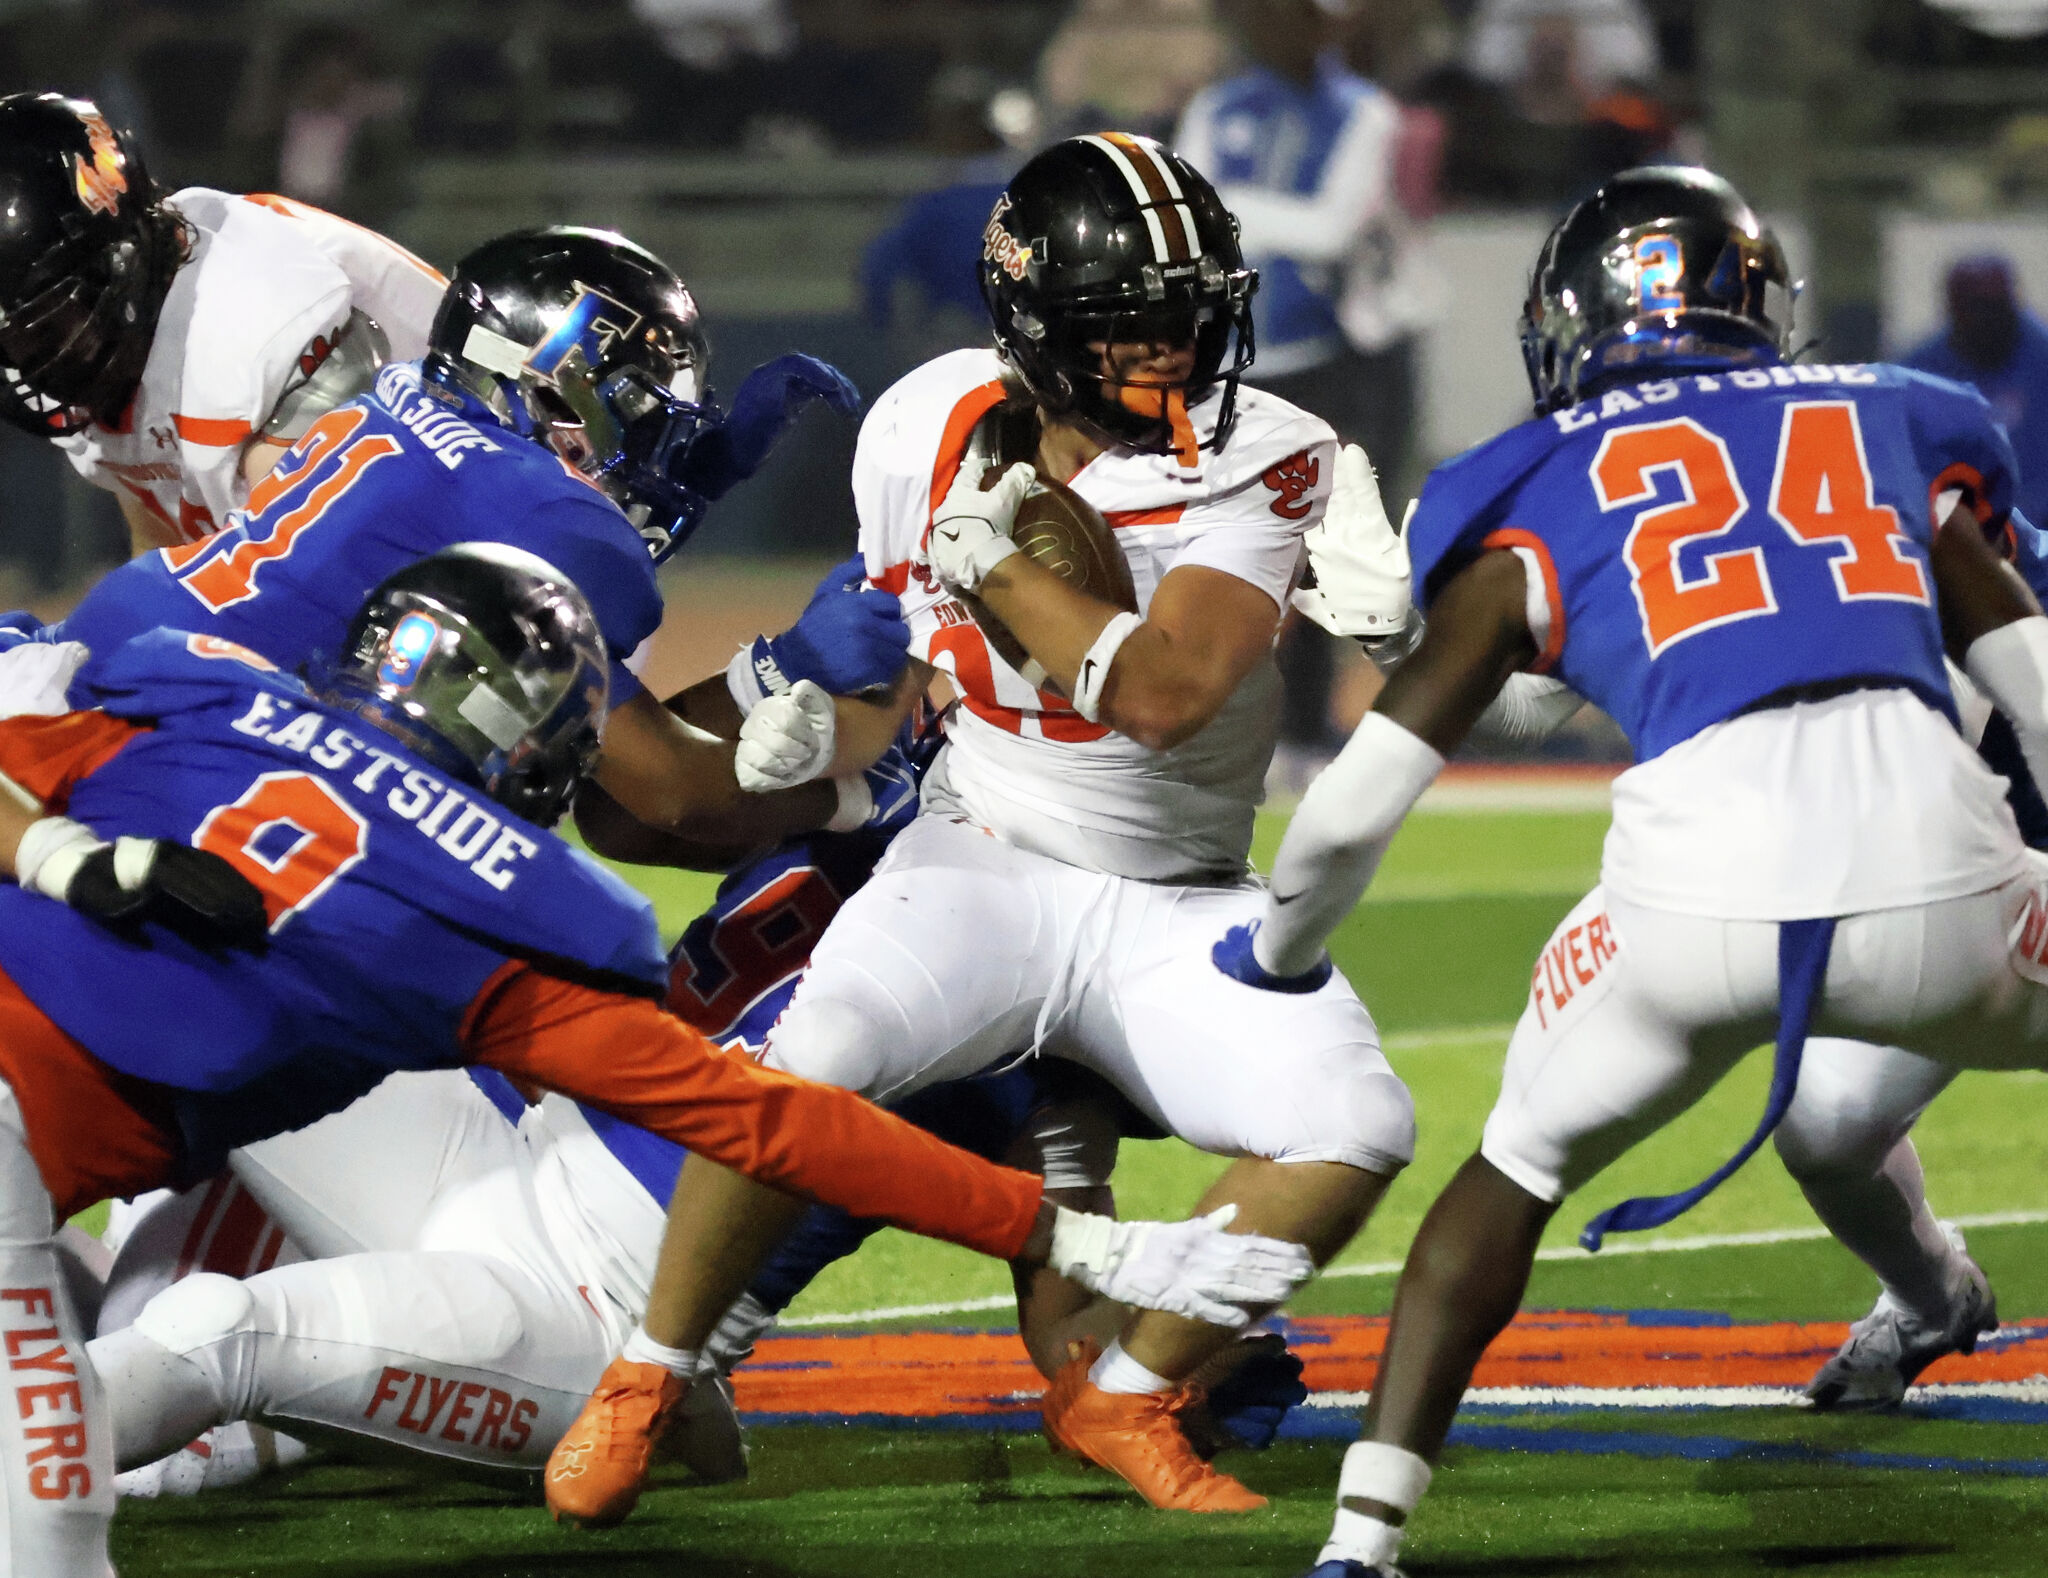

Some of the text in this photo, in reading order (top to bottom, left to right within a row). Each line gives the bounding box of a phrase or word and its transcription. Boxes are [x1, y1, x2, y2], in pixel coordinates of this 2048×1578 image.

[982, 191, 1032, 281] Tigers
[521, 279, 643, 386] F
[1553, 363, 1877, 434] EASTSIDE
[159, 404, 405, 615] 21
[1588, 399, 1931, 661] 24
[376, 609, 441, 694] 9
[932, 600, 975, 628] EDW
[230, 691, 538, 891] EASTSIDE
[0, 1287, 92, 1501] FLYERS
[363, 1366, 540, 1452] FLYERS
